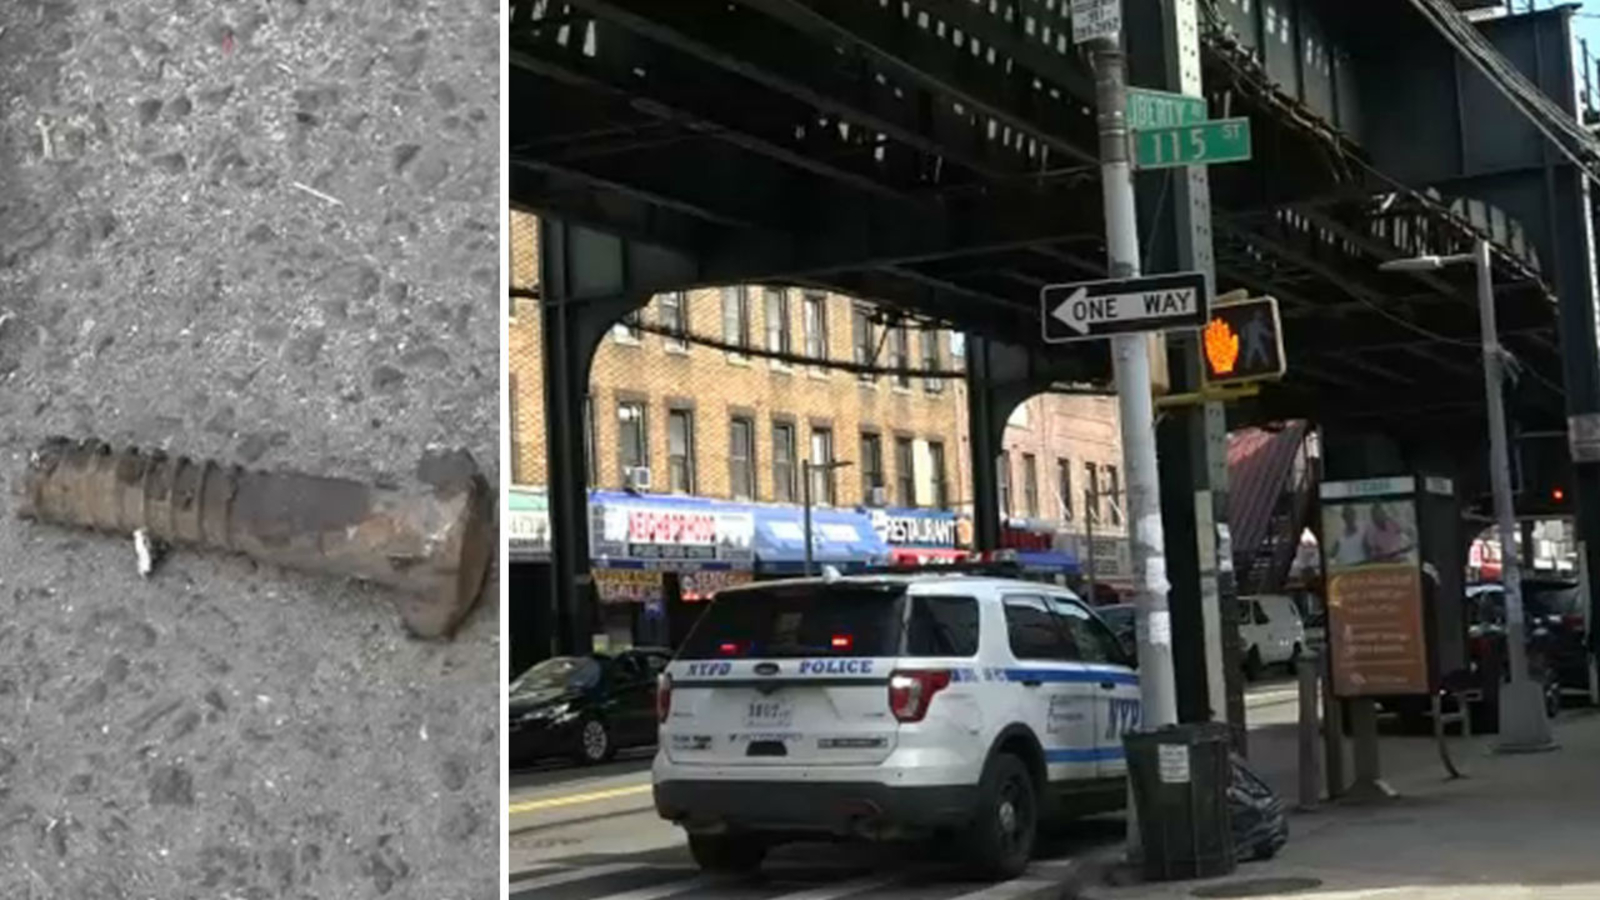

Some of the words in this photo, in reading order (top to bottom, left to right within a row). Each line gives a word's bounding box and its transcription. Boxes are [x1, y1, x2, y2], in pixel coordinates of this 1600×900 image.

[1153, 129, 1206, 164] 115
[1223, 123, 1239, 138] ST
[1072, 299, 1118, 321] ONE
[1143, 291, 1191, 314] WAY
[885, 516, 956, 544] RESTAURANT
[687, 662, 732, 676] NYPD
[799, 659, 873, 675] POLICE
